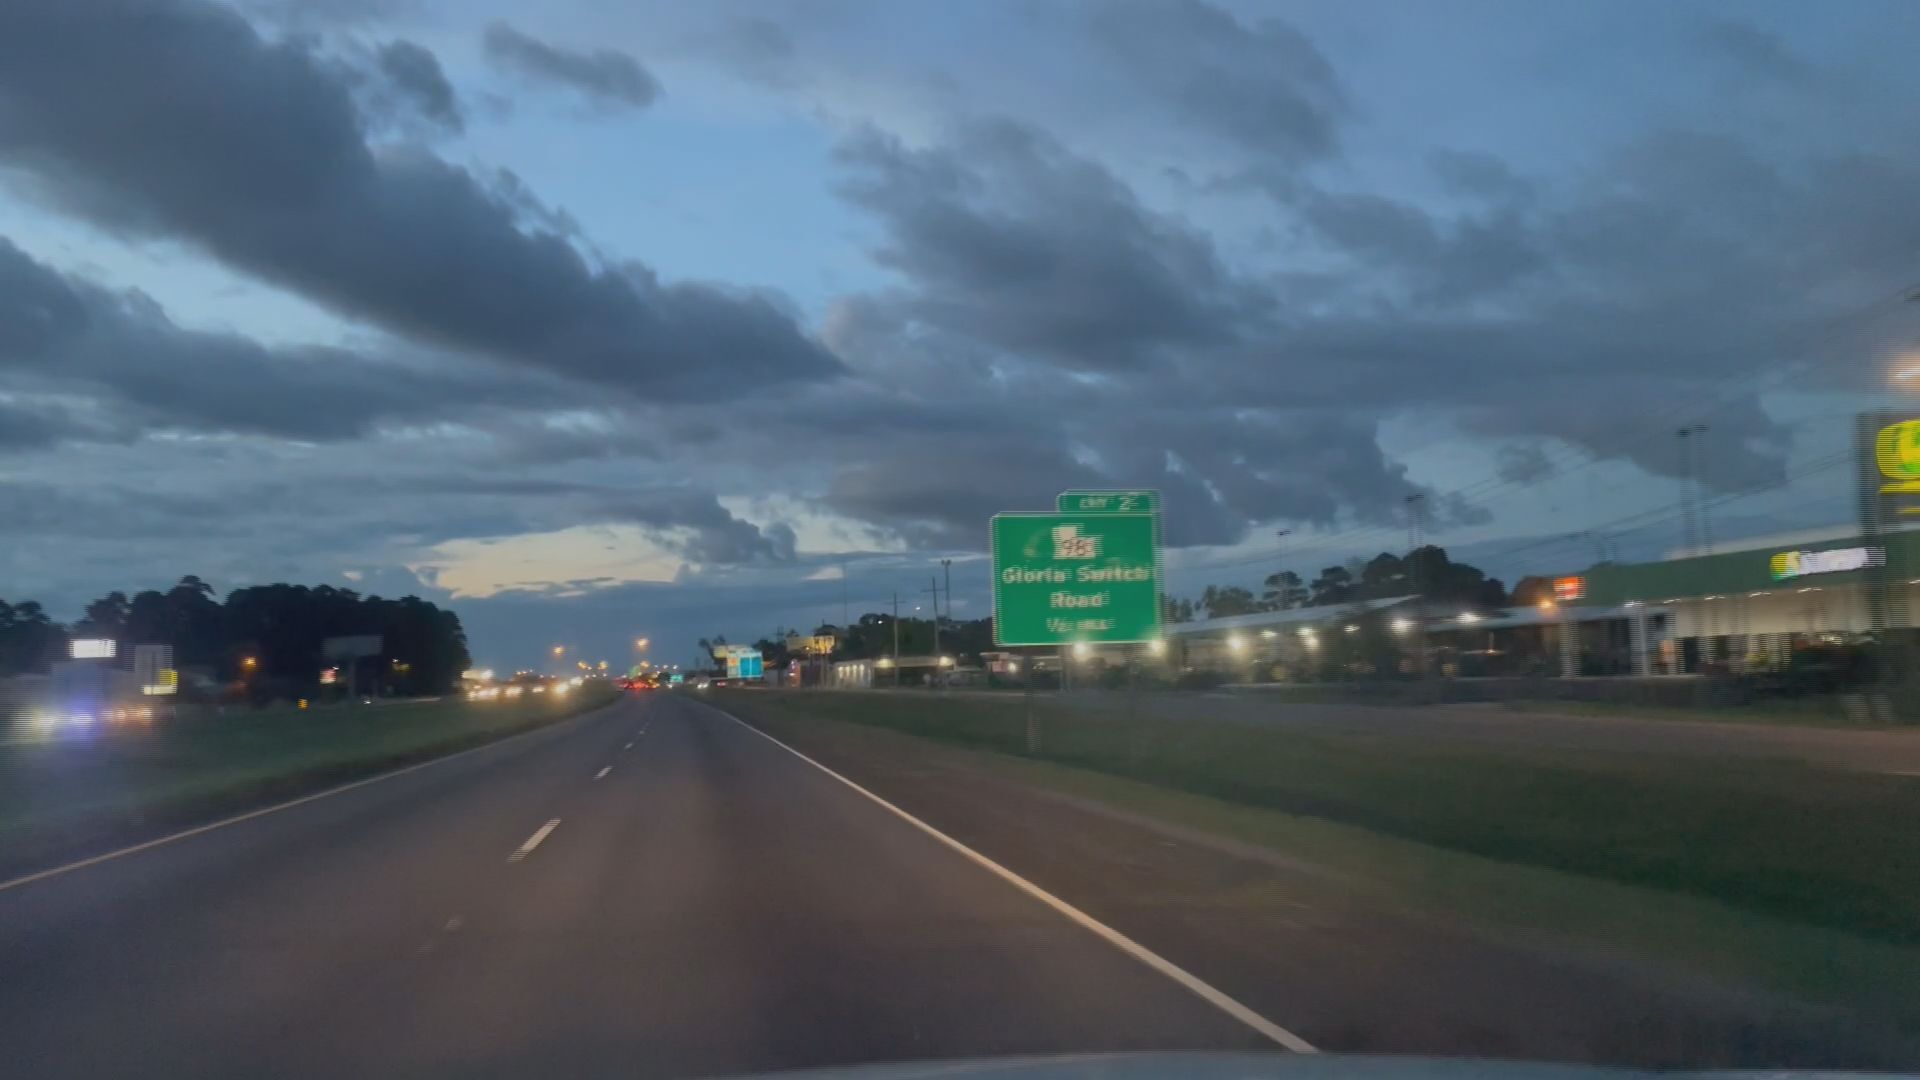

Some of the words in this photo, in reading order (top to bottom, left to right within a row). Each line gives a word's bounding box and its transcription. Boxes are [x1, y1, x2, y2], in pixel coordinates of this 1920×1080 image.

[1002, 566, 1067, 584] Gloria
[1076, 565, 1150, 582] Switch
[1050, 591, 1106, 608] Road
